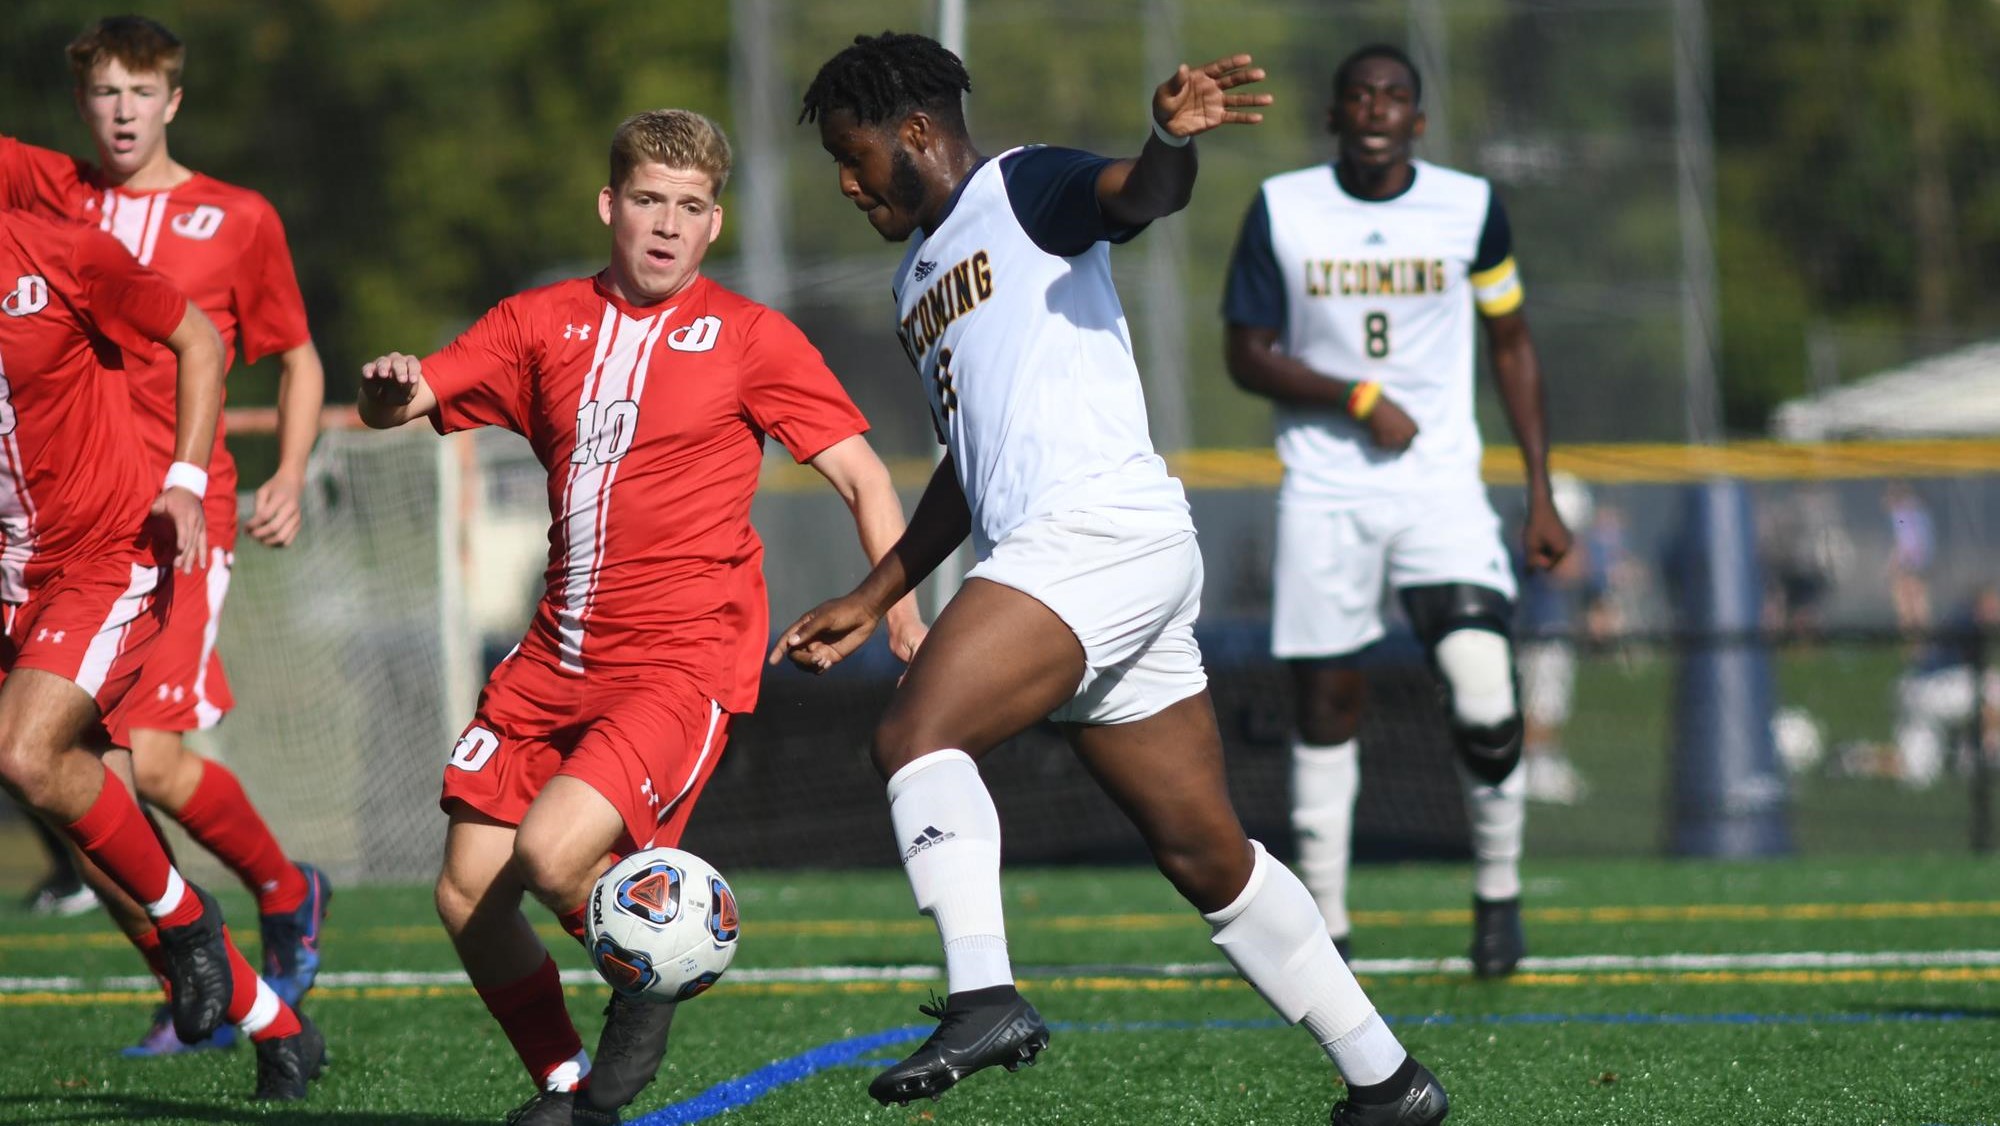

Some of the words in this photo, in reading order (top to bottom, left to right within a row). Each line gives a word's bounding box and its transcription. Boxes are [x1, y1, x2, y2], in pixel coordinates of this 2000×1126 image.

[1305, 257, 1445, 297] LYCOMING
[1365, 311, 1389, 358] 8
[570, 400, 640, 464] 10
[903, 832, 956, 865] adidas
[593, 884, 604, 927] NCAA
